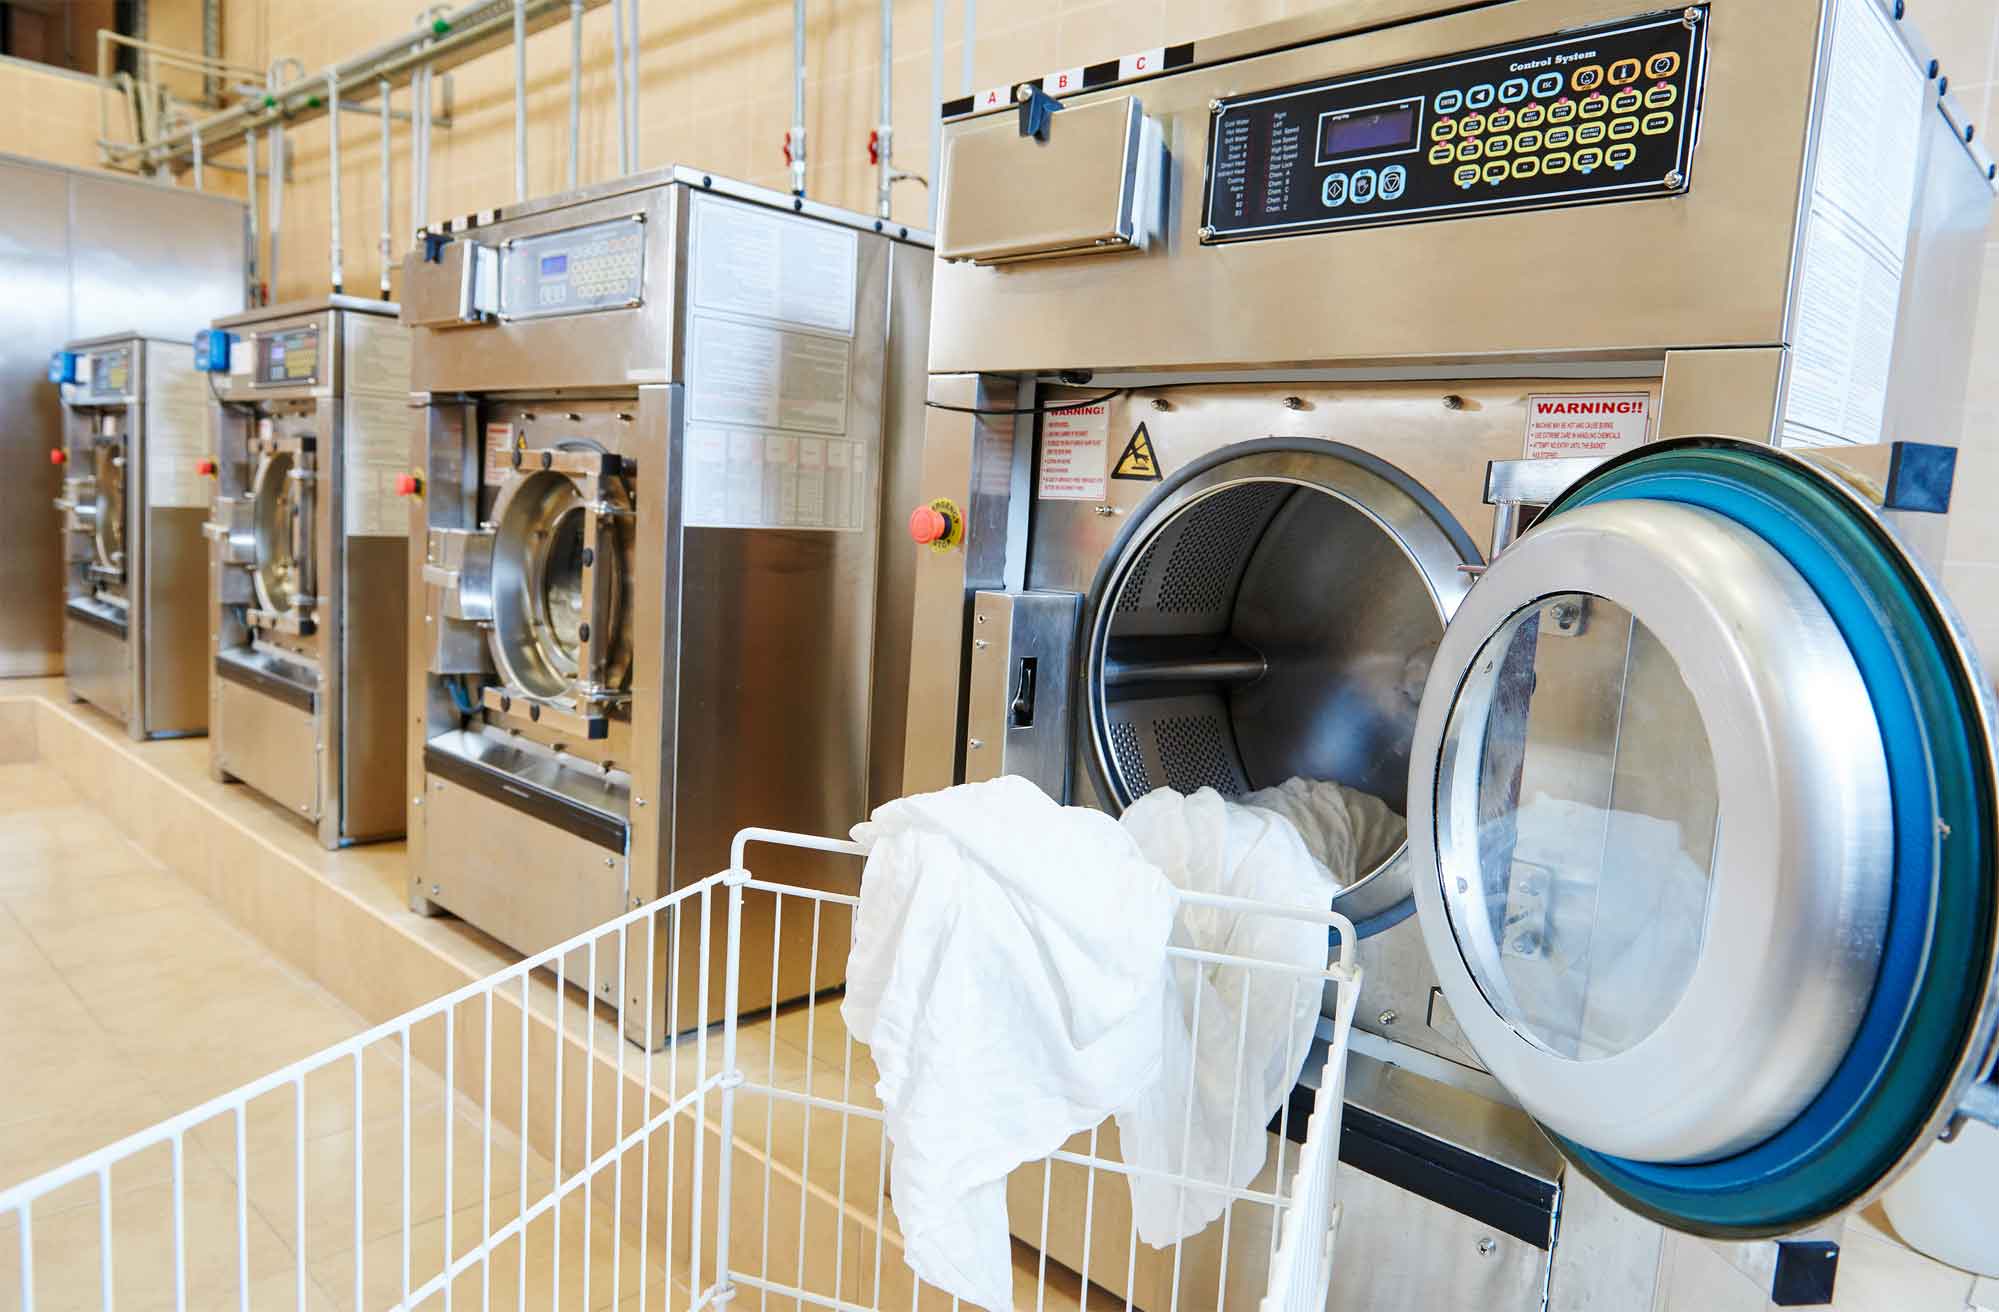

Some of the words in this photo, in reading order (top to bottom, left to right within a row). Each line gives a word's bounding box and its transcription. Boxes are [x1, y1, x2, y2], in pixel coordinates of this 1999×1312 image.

[1136, 57, 1146, 70] C
[1509, 57, 1552, 72] Control
[1555, 51, 1597, 65] System
[1058, 75, 1068, 89] B
[1542, 81, 1552, 89] ESC
[987, 92, 997, 104] A
[1537, 402, 1643, 414] WARNING!!
